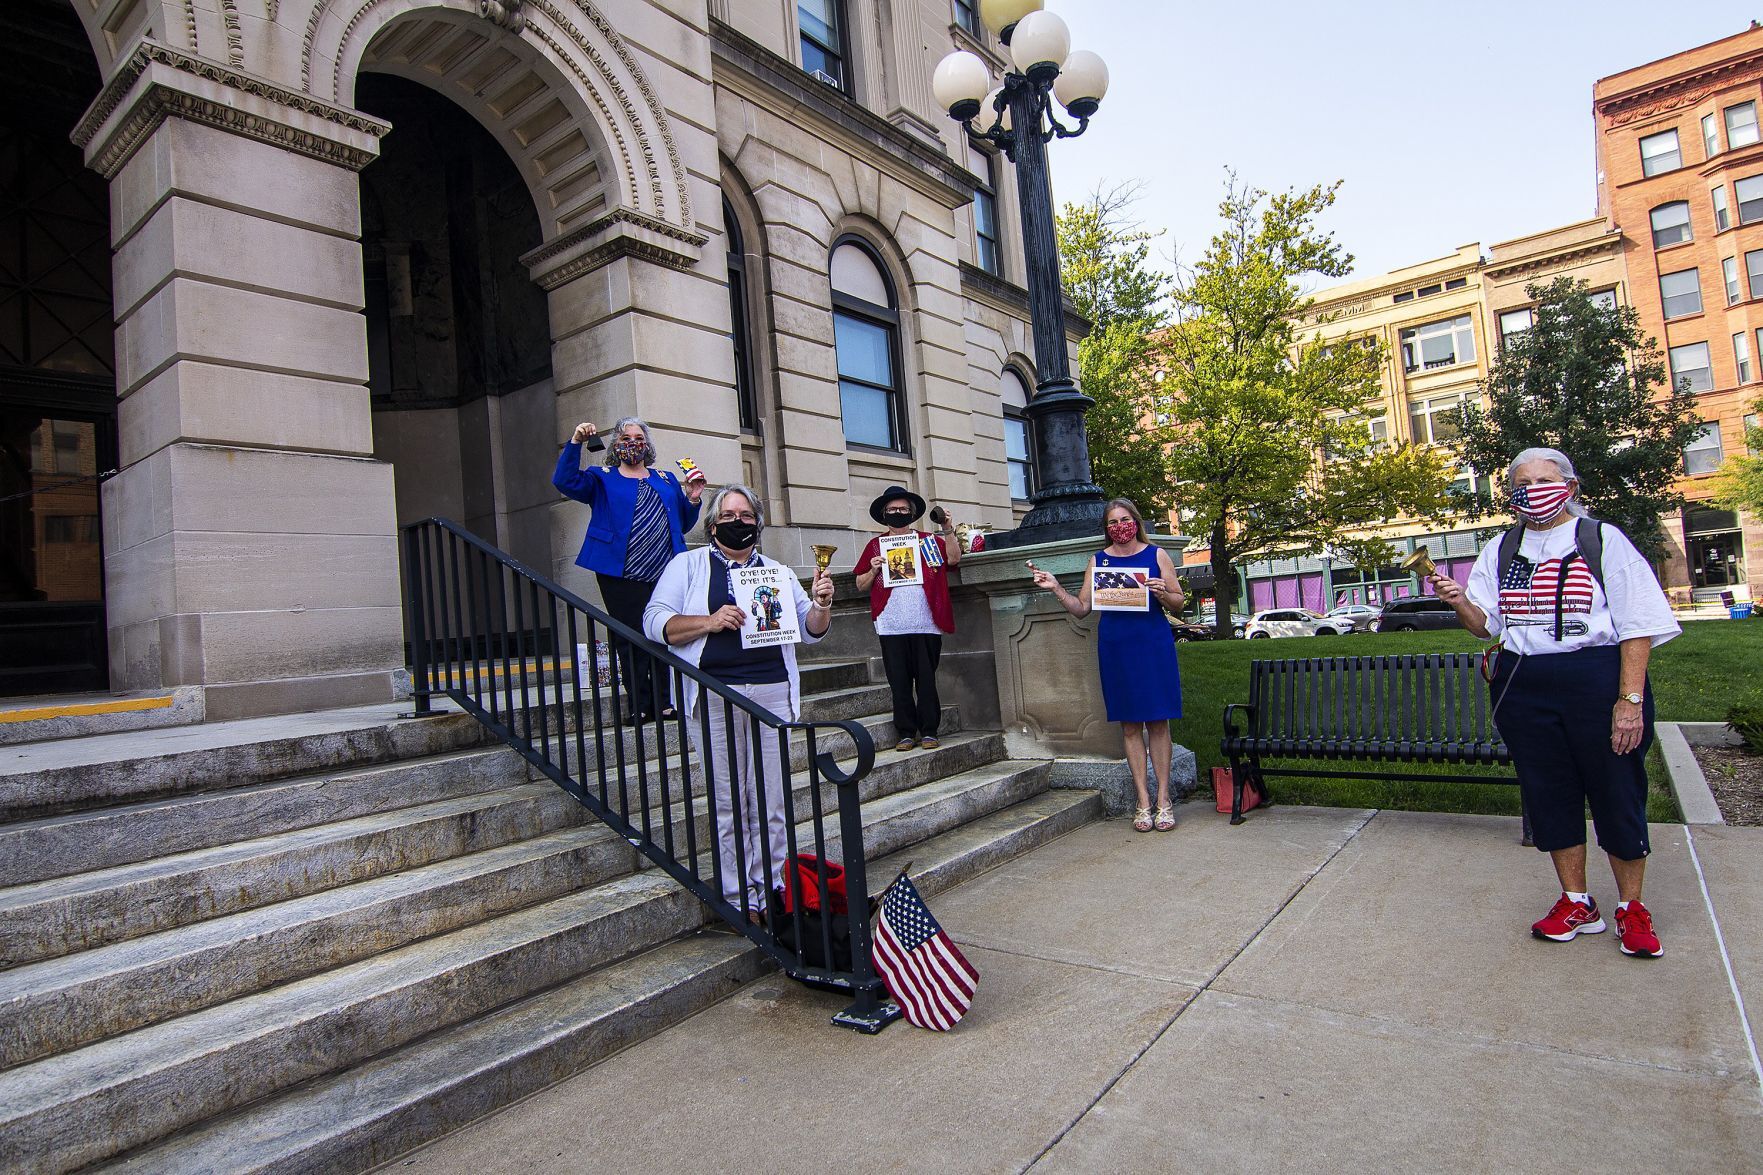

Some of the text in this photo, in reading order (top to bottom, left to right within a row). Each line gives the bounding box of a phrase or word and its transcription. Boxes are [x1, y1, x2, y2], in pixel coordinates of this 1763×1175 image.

[880, 535, 917, 543] CONSTITUTION
[740, 568, 779, 577] O'YE! O'YE!
[740, 577, 760, 585] O'YE!
[745, 631, 782, 639] CONSTITUTION
[750, 637, 780, 645] SEPTEMBER
